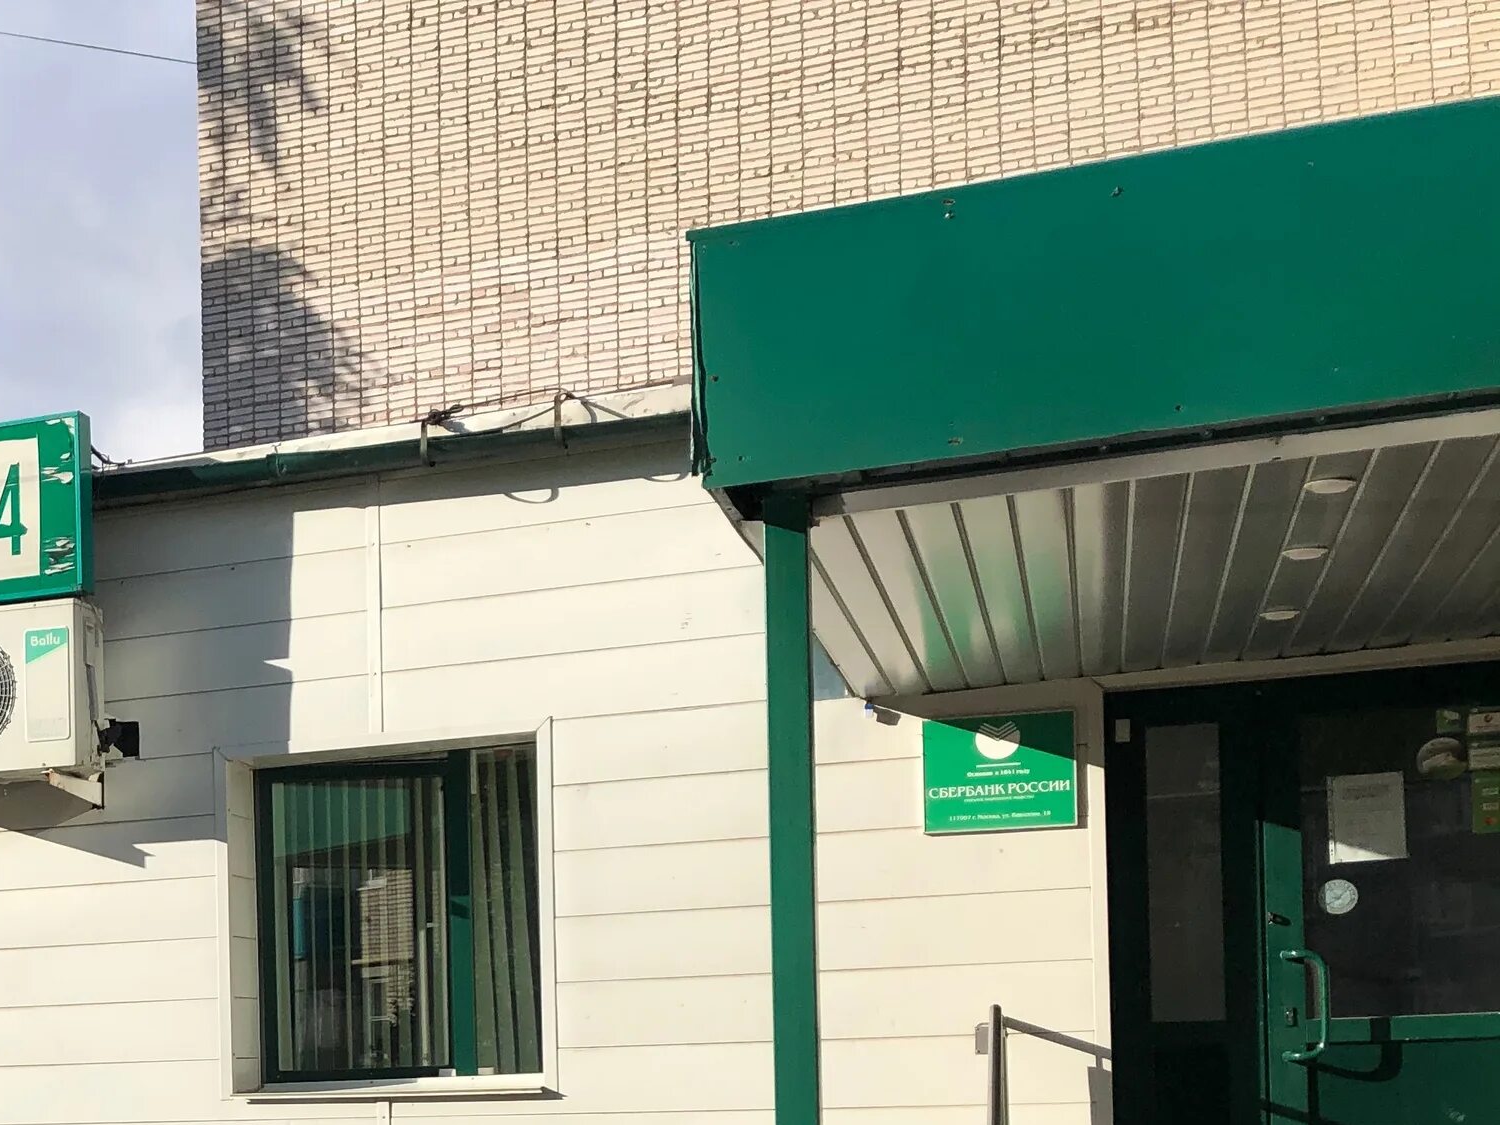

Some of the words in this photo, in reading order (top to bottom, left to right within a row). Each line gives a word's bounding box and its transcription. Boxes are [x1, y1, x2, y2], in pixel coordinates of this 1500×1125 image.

[30, 632, 61, 647] Ballu
[928, 783, 1005, 800] СБЕРБАНК
[1008, 779, 1071, 795] РОССИИ
